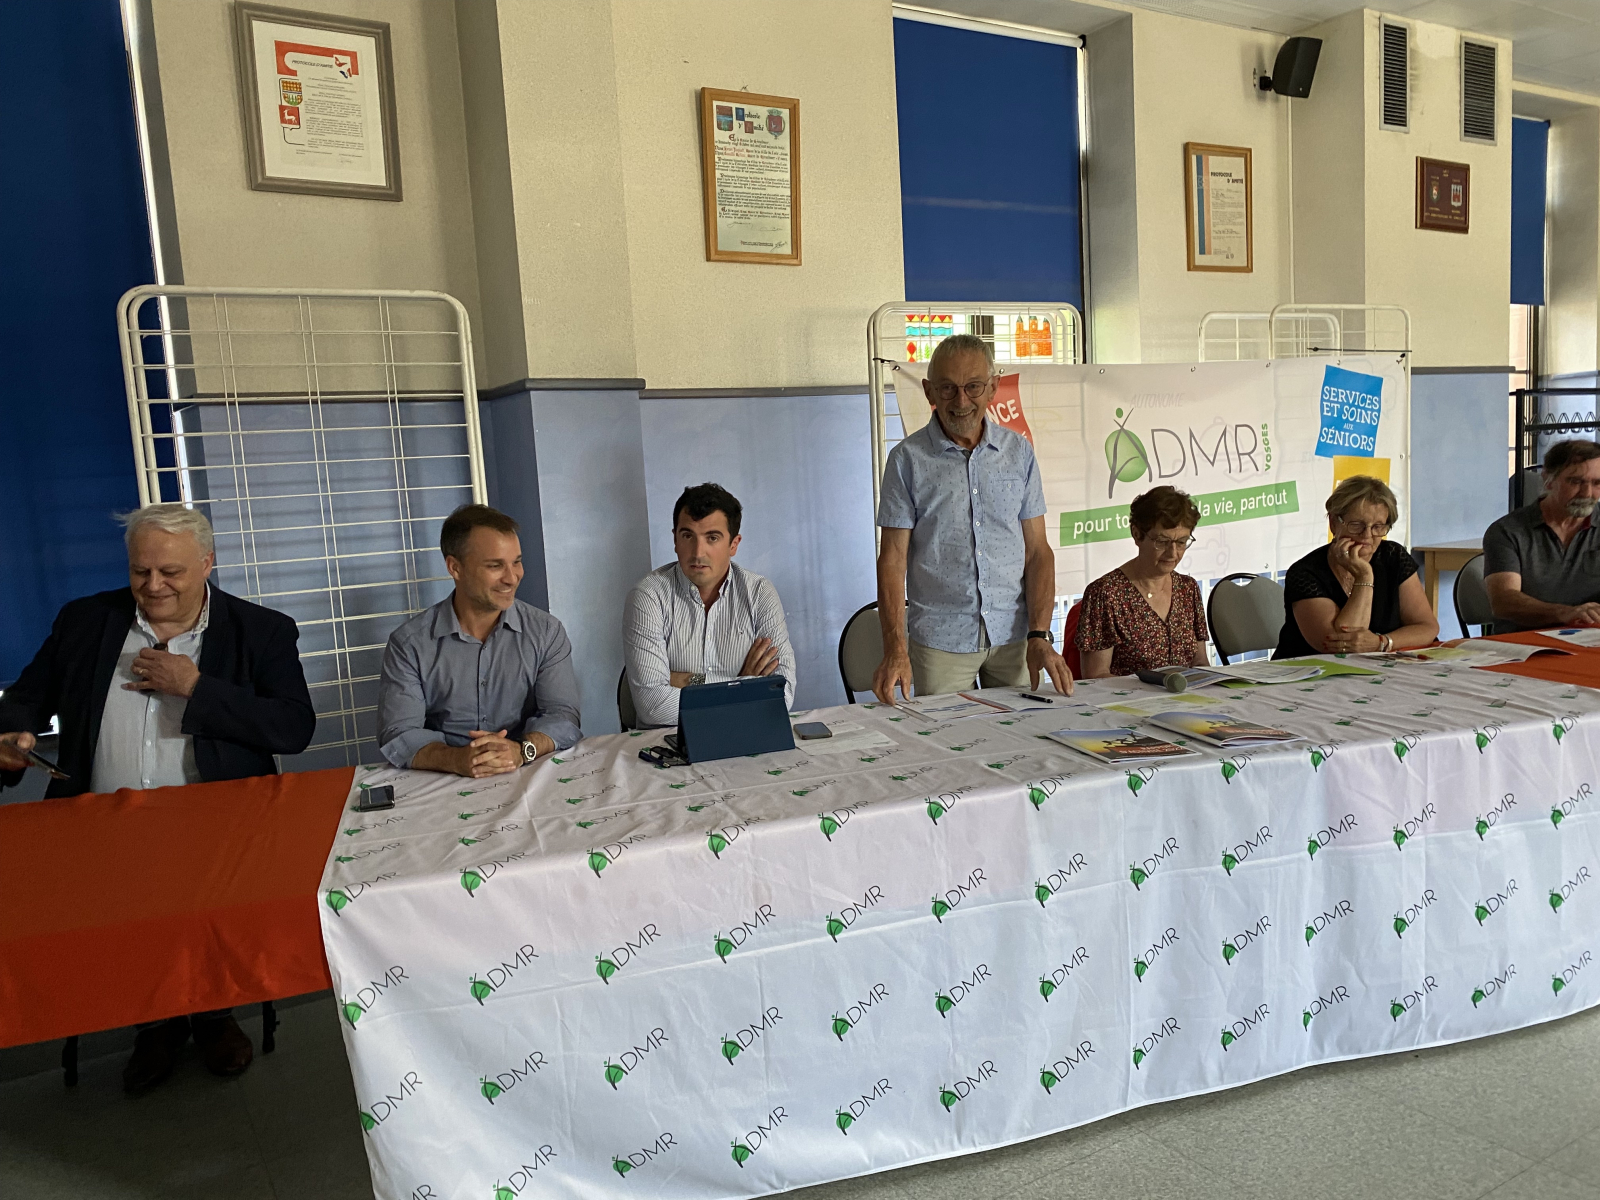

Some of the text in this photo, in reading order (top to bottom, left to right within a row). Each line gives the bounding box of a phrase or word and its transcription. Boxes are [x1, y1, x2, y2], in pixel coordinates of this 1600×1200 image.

[1130, 392, 1186, 409] AUTONOME
[1322, 385, 1379, 410] SERVICES
[1323, 401, 1379, 426] ET SOINS
[1105, 407, 1259, 499] ADMR
[1261, 423, 1272, 471] VOSGES
[1320, 426, 1374, 451] SÉNIORS
[1074, 517, 1112, 539] pour
[1199, 501, 1210, 517] la
[1213, 499, 1237, 516] vie,
[1240, 489, 1288, 515] partout
[817, 799, 870, 842] ADMR
[925, 784, 976, 826] ADMR
[1393, 803, 1436, 851] ADMR
[1475, 793, 1517, 841] ADMR
[1550, 783, 1593, 830] ADMR
[587, 833, 649, 878] ADMR
[706, 817, 765, 860] ADMR
[1222, 825, 1273, 876] ADMR
[1307, 814, 1358, 861] ADMR
[459, 851, 529, 898] ADMR
[1035, 852, 1087, 908] ADMR
[1129, 837, 1179, 891] ADMR
[325, 871, 400, 917] ADMR
[825, 885, 884, 943] ADMR
[931, 867, 987, 923] ADMR
[1393, 889, 1437, 939] ADMR
[1475, 879, 1518, 927] ADMR
[1549, 866, 1591, 914] ADMR
[714, 904, 776, 964] ADMR
[1222, 915, 1272, 965] ADMR
[1305, 899, 1354, 947] ADMR
[469, 944, 539, 1006] ADMR
[595, 923, 661, 985] ADMR
[1039, 946, 1089, 1002] ADMR
[1134, 927, 1180, 983] ADMR
[1552, 951, 1593, 997] ADMR
[340, 965, 409, 1030] ADMR
[935, 963, 992, 1018] ADMR
[1302, 986, 1350, 1032] ADMR
[1390, 976, 1438, 1022] ADMR
[1471, 964, 1517, 1009] ADMR
[720, 1006, 783, 1065] ADMR
[831, 983, 890, 1041] ADMR
[1220, 1003, 1270, 1052] ADMR
[604, 1027, 669, 1090] ADMR
[1039, 1040, 1095, 1094] ADMR
[1132, 1017, 1181, 1070] ADMR
[480, 1051, 548, 1105] ADMR
[939, 1060, 998, 1112] ADMR
[835, 1078, 893, 1136] ADMR
[612, 1132, 678, 1178] ADMR
[730, 1106, 789, 1168] ADMR
